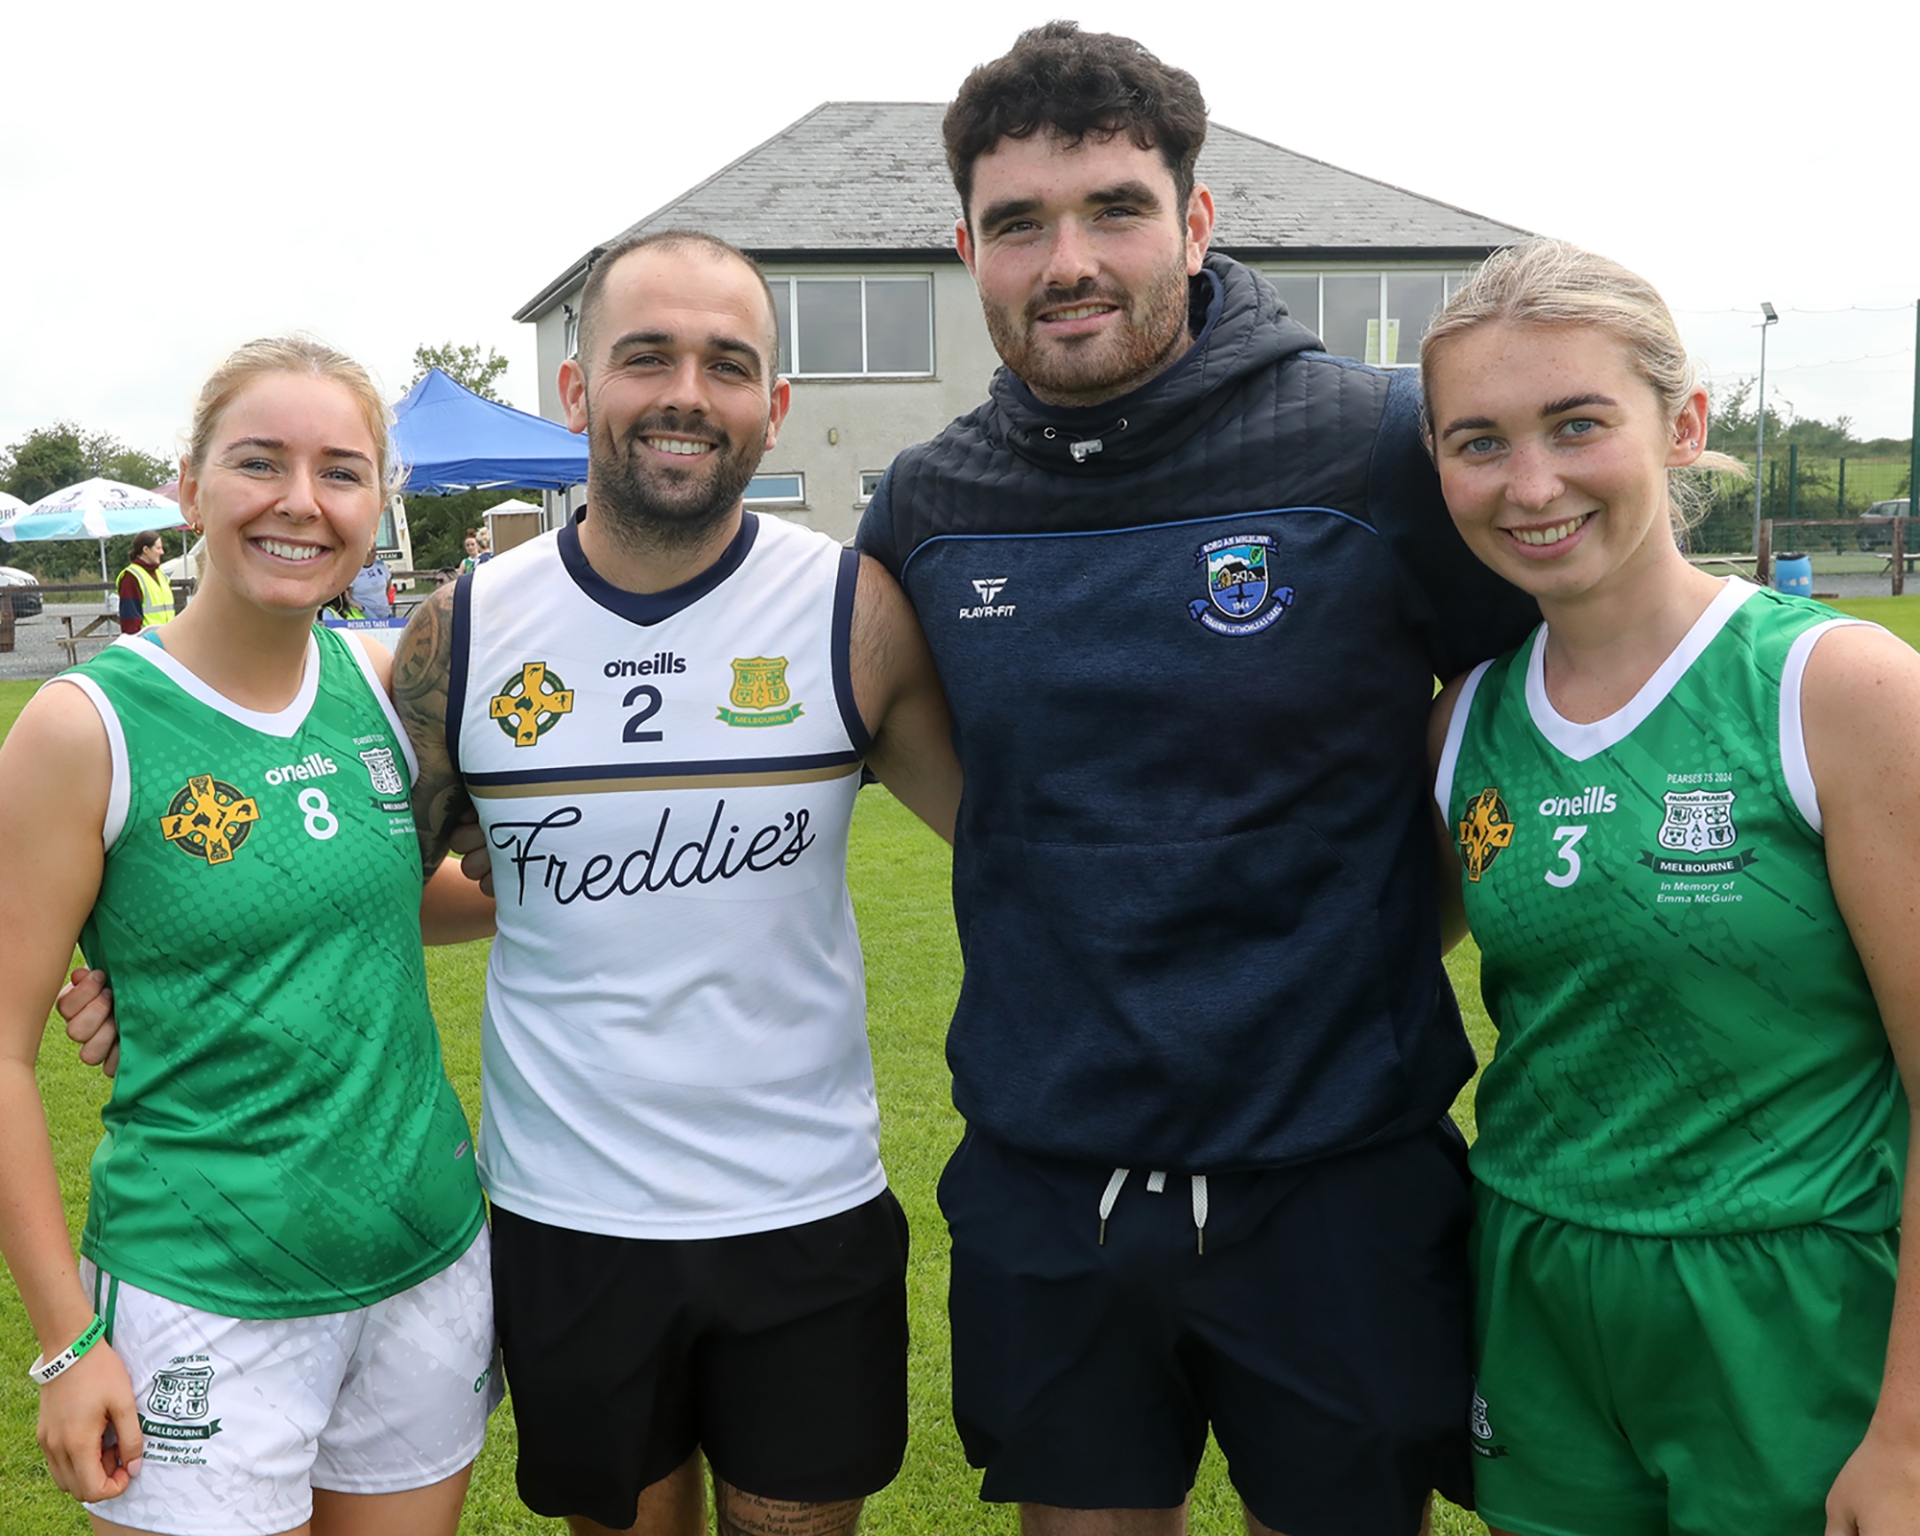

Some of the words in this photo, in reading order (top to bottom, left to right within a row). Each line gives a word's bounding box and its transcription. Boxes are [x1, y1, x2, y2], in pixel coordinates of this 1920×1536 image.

[959, 605, 1016, 619] PLAYR-FIT
[347, 621, 372, 629] RESULTS
[372, 620, 390, 628] TABLE
[622, 684, 663, 743] 2
[735, 714, 787, 724] MELBOURNE
[1666, 774, 1703, 784] PEARSES
[1715, 773, 1732, 782] 2024
[1702, 794, 1729, 802] PEARSE
[298, 787, 339, 840] 8
[490, 799, 816, 906] Freddie's
[1544, 825, 1588, 888] 3
[1660, 861, 1734, 873] MELBOURNE
[1660, 882, 1671, 891] In
[1673, 882, 1720, 892] Memory
[1722, 881, 1735, 890] of
[1657, 894, 1691, 903] Emma
[1694, 893, 1743, 903] McGuire
[65, 1349, 80, 1360] 7s
[41, 1360, 65, 1379] 2025
[147, 1424, 204, 1437] MELBOURNE
[147, 1441, 156, 1449] In
[156, 1443, 191, 1454] Memory
[192, 1446, 203, 1454] of
[143, 1451, 168, 1462] Emma
[170, 1455, 207, 1465] McGuire
